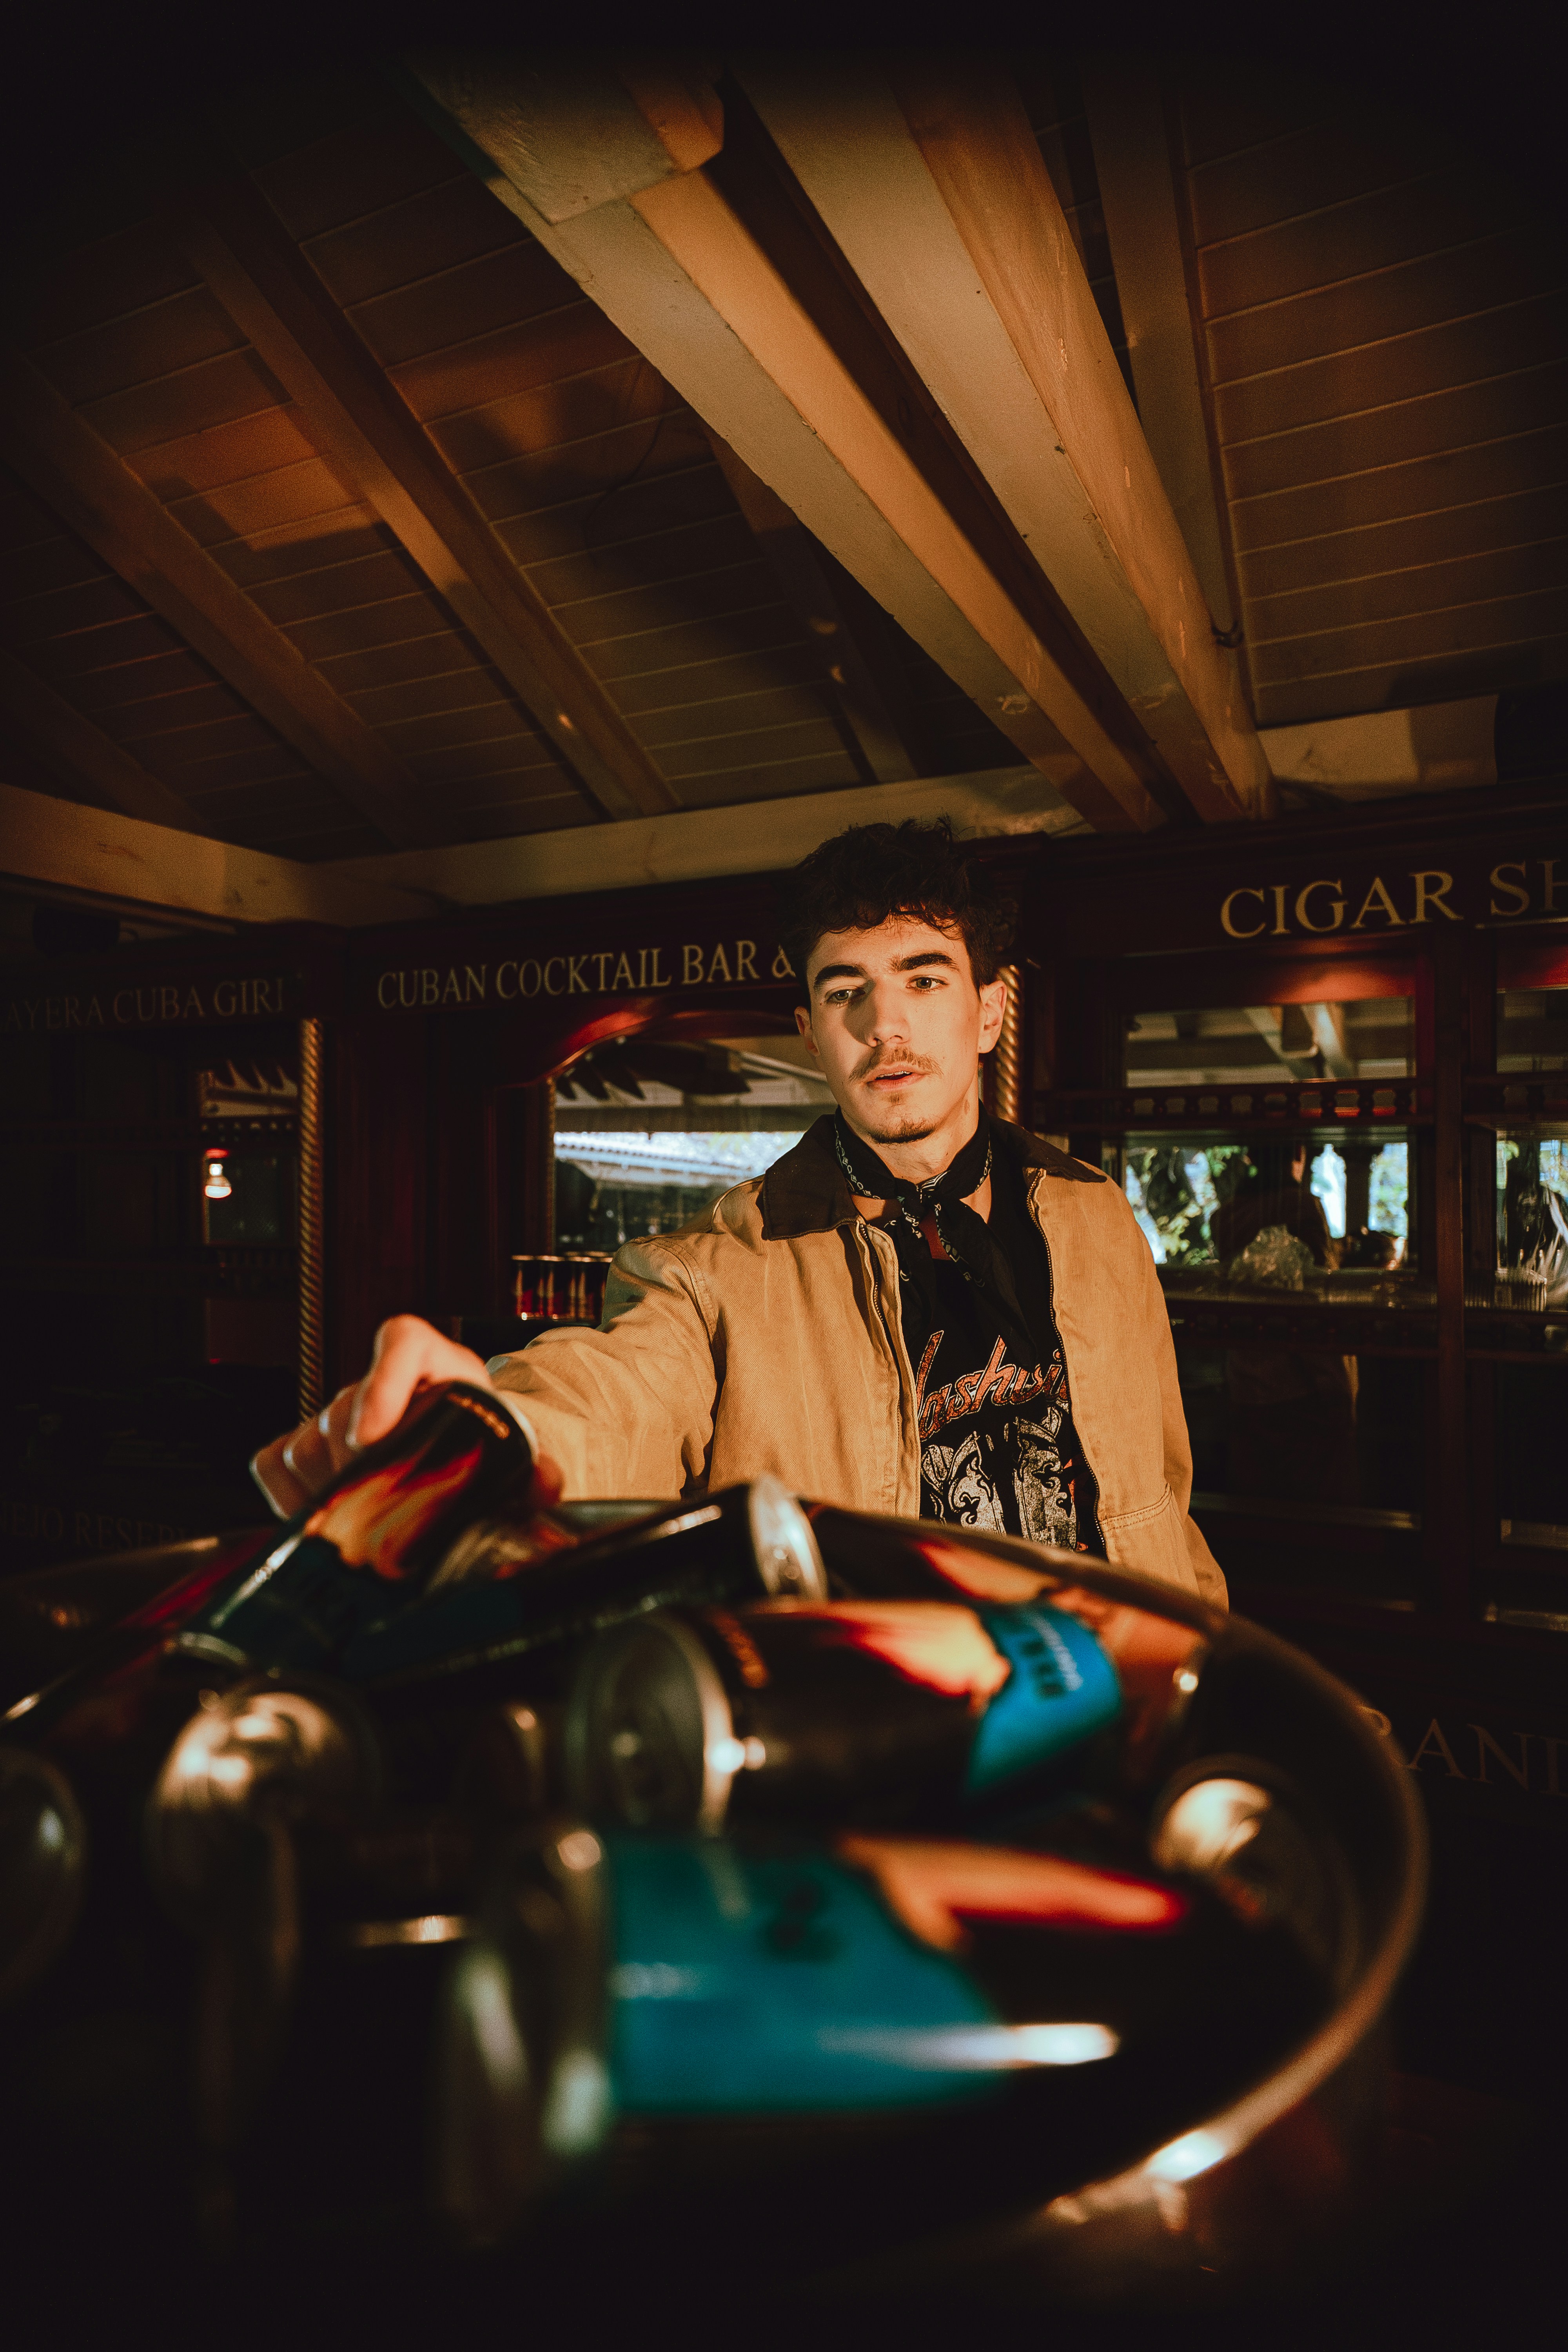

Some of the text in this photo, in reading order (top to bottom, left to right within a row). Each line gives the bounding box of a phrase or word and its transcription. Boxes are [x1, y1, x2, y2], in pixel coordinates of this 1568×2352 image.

[1220, 870, 1465, 939] CIGAR
[112, 985, 205, 1023] CUBA
[377, 964, 488, 1009] CUBAN
[495, 947, 672, 1000] COCKTAIL
[681, 940, 761, 985] BAR
[915, 1330, 1072, 1443] ashvi
